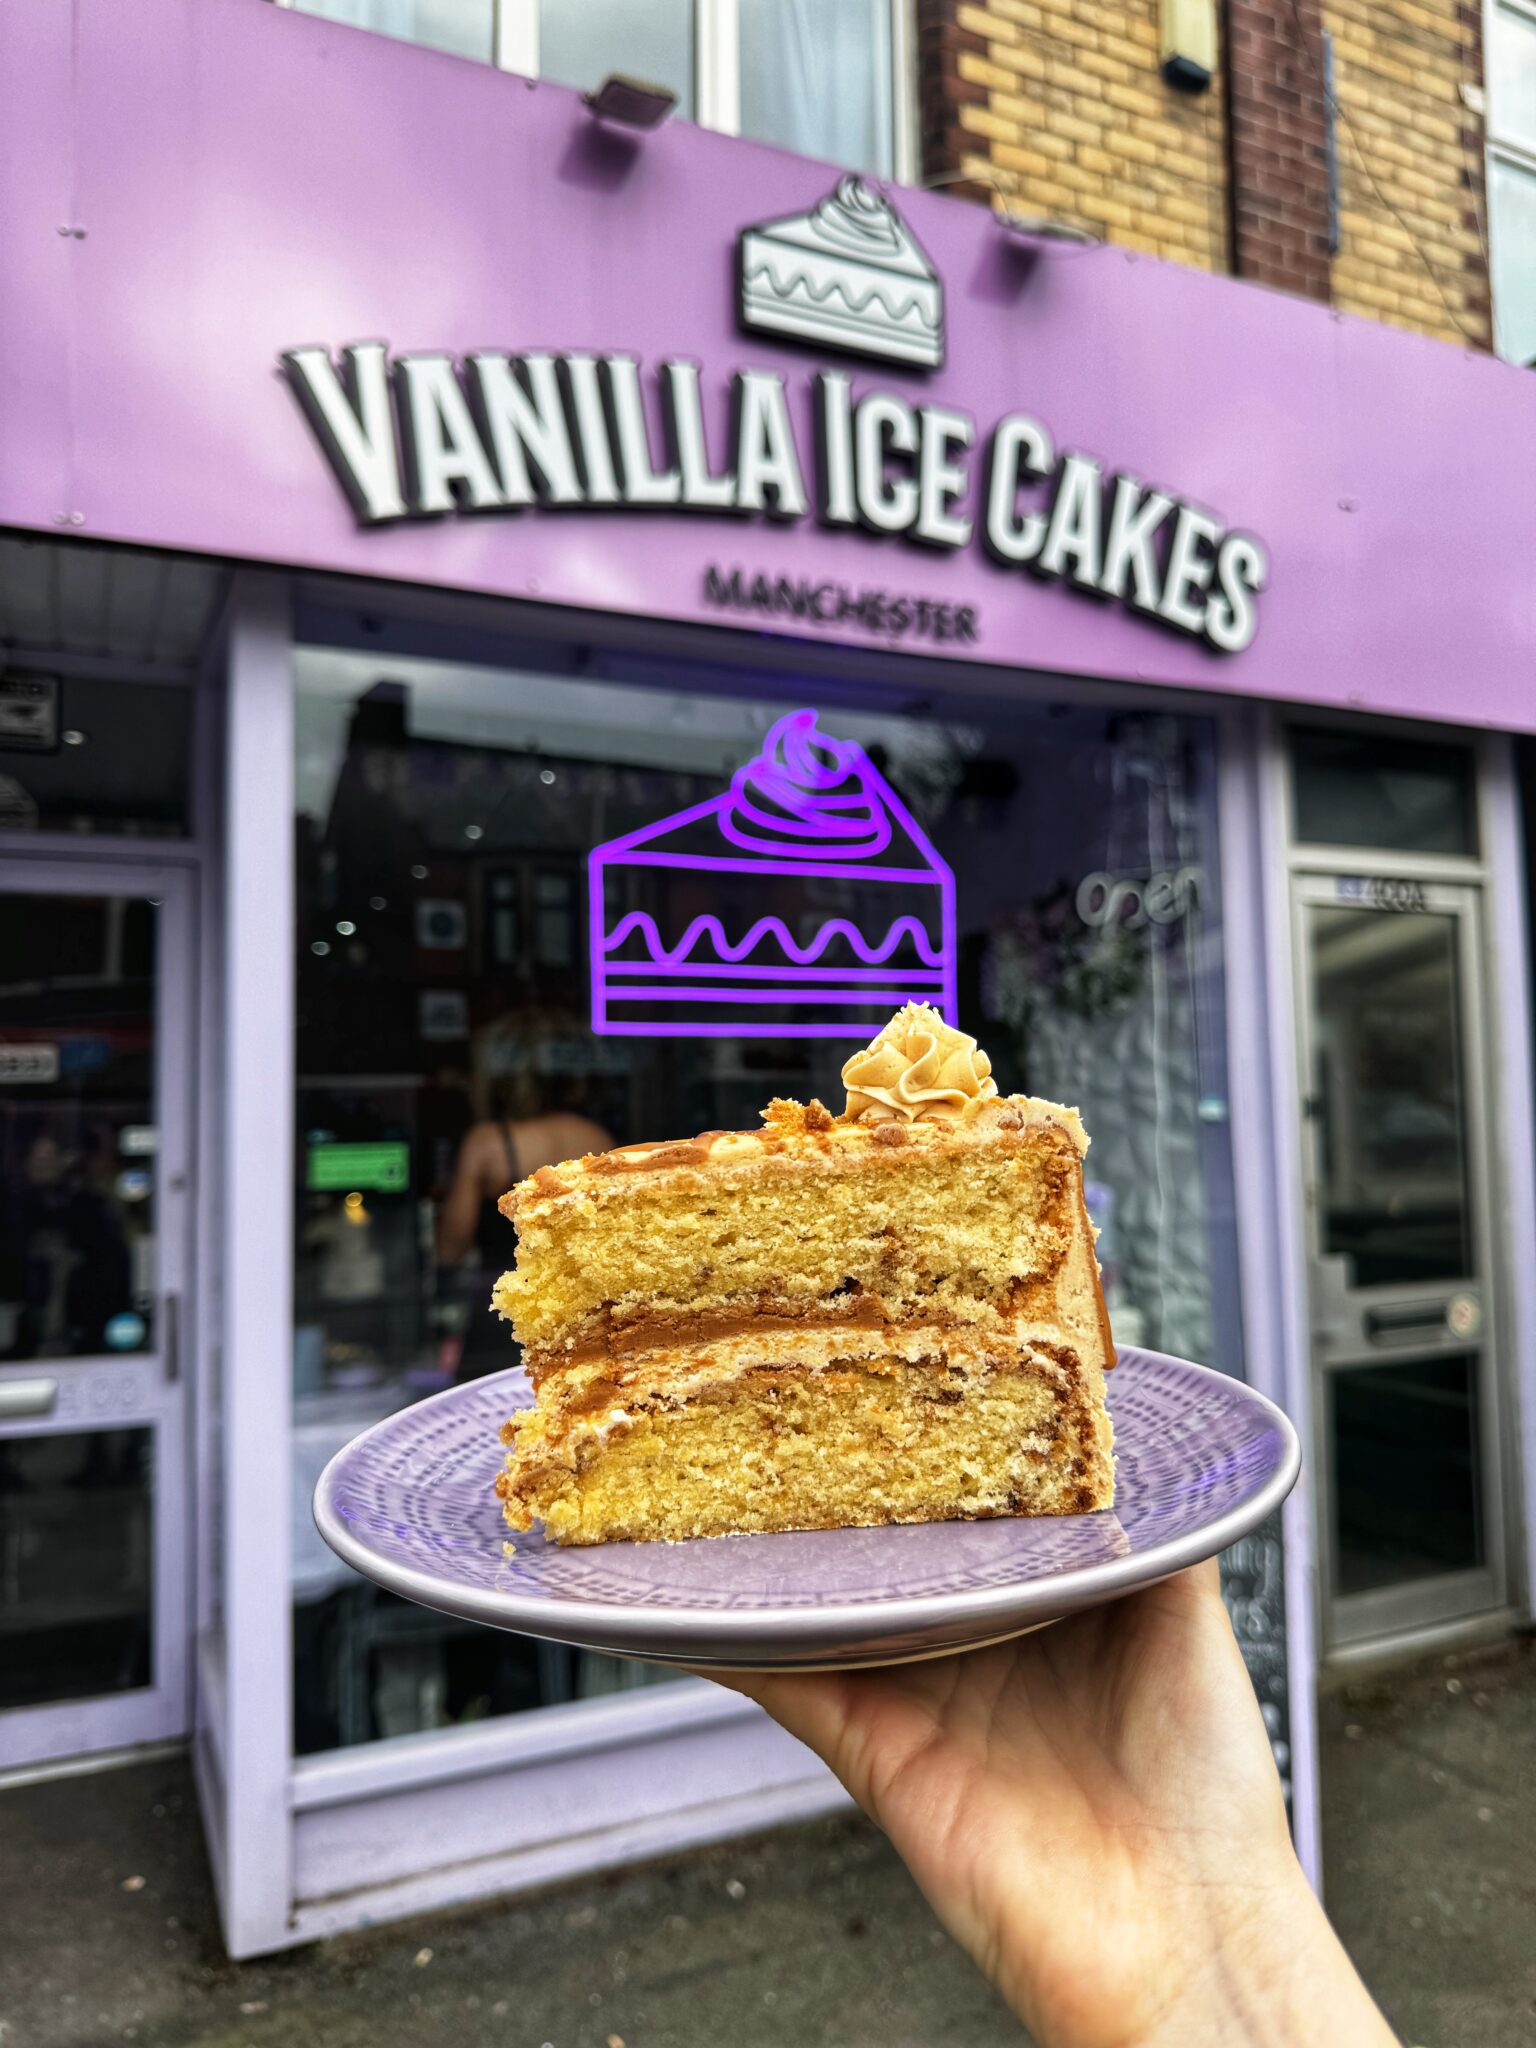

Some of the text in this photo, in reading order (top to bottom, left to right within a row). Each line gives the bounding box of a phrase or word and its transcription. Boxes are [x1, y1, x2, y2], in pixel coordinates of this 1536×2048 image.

[276, 342, 1270, 655] VANILLA ICE CAKES
[703, 564, 978, 643] MANCHESTER
